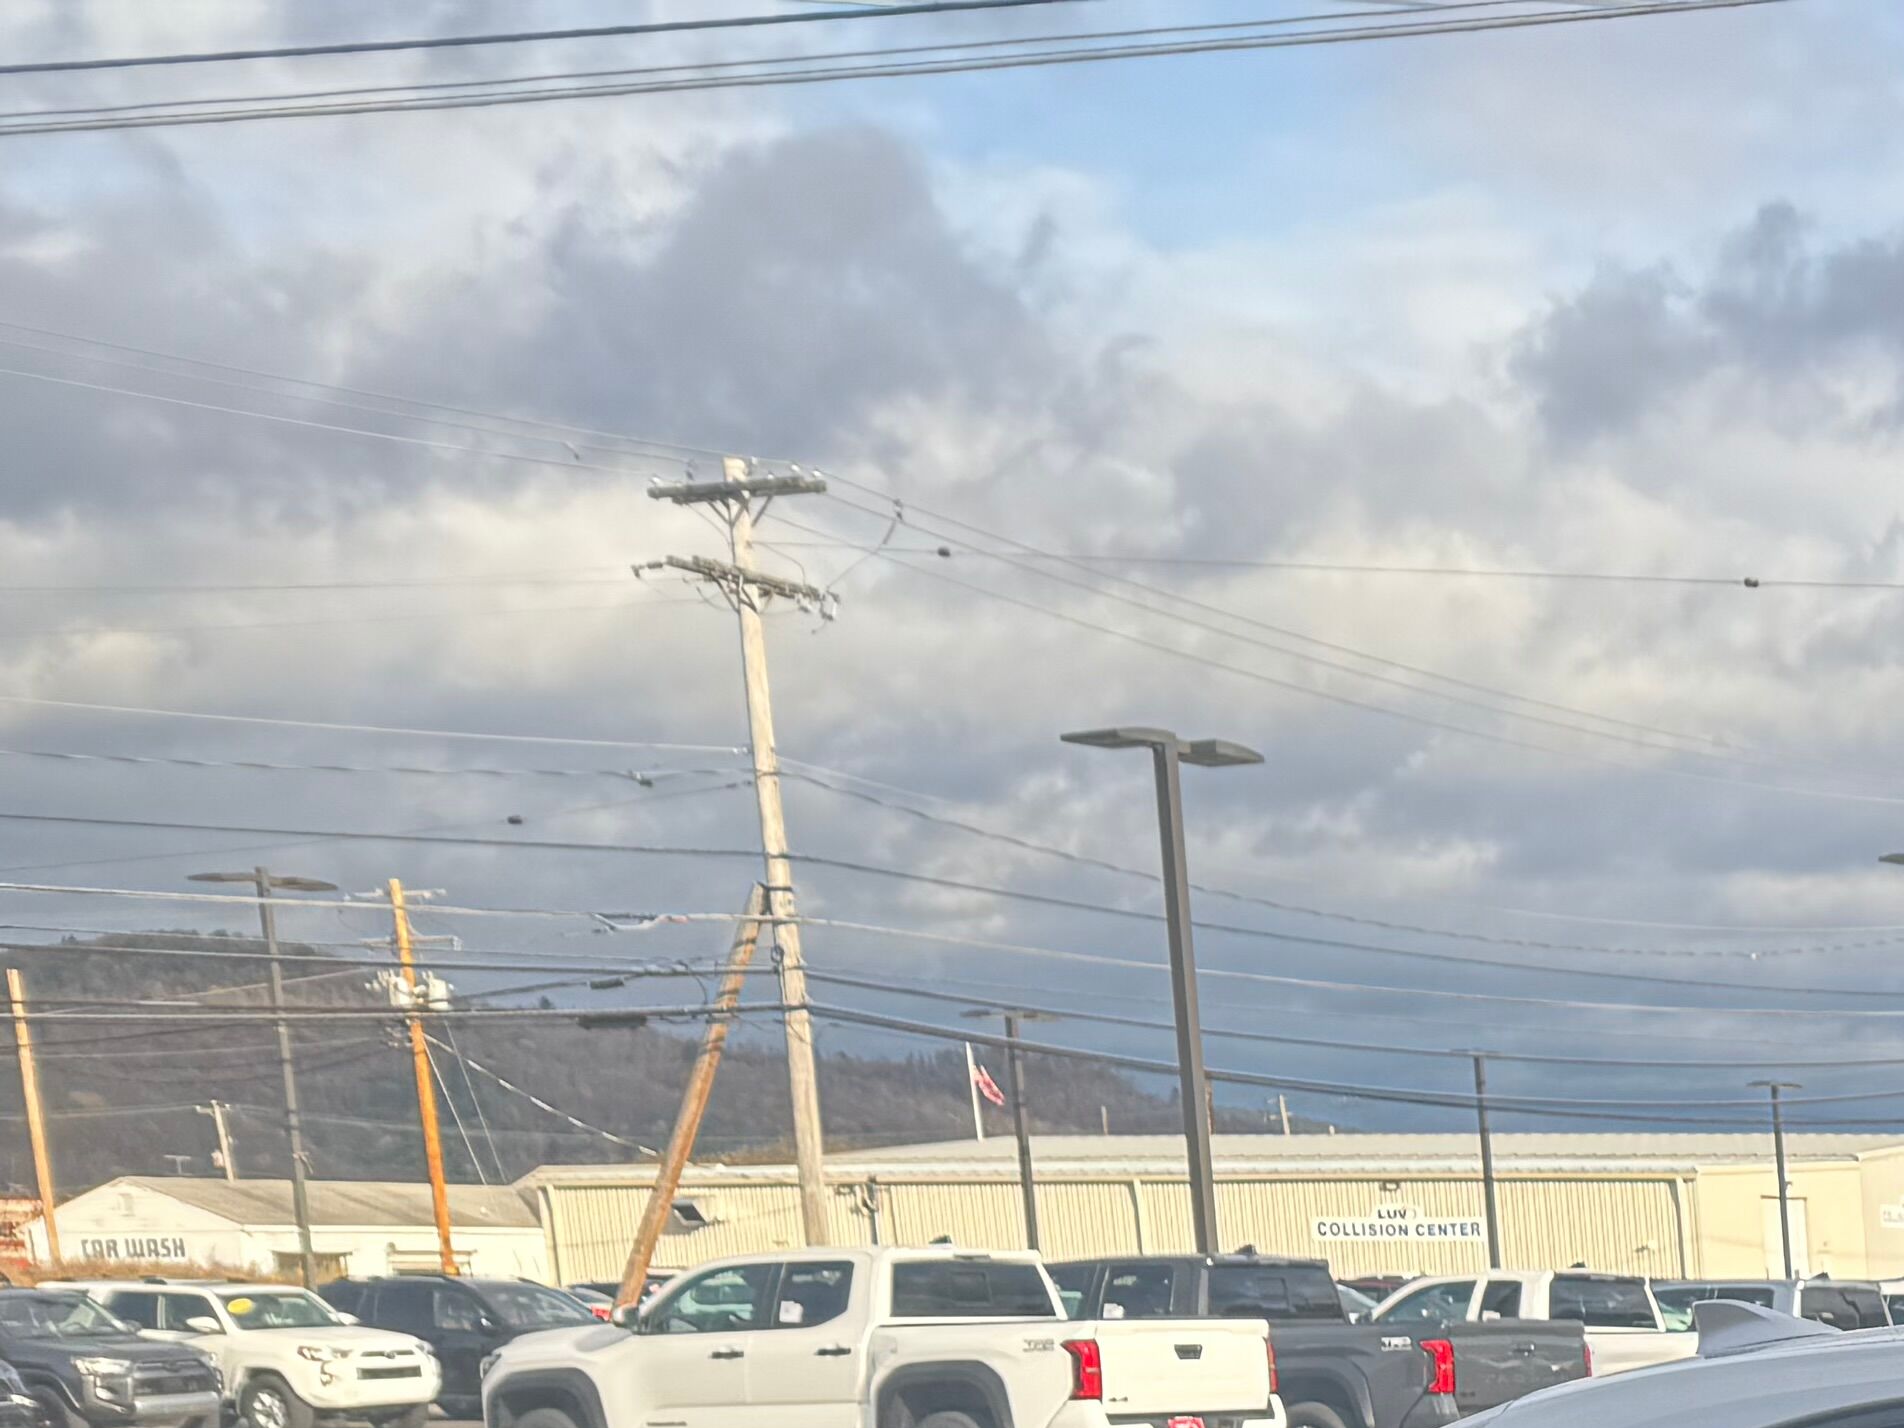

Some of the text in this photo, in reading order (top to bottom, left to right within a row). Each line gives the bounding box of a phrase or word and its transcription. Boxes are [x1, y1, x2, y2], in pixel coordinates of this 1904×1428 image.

[1317, 1222, 1481, 1236] COLLISION CENTER
[81, 1237, 186, 1258] CAR WASH
